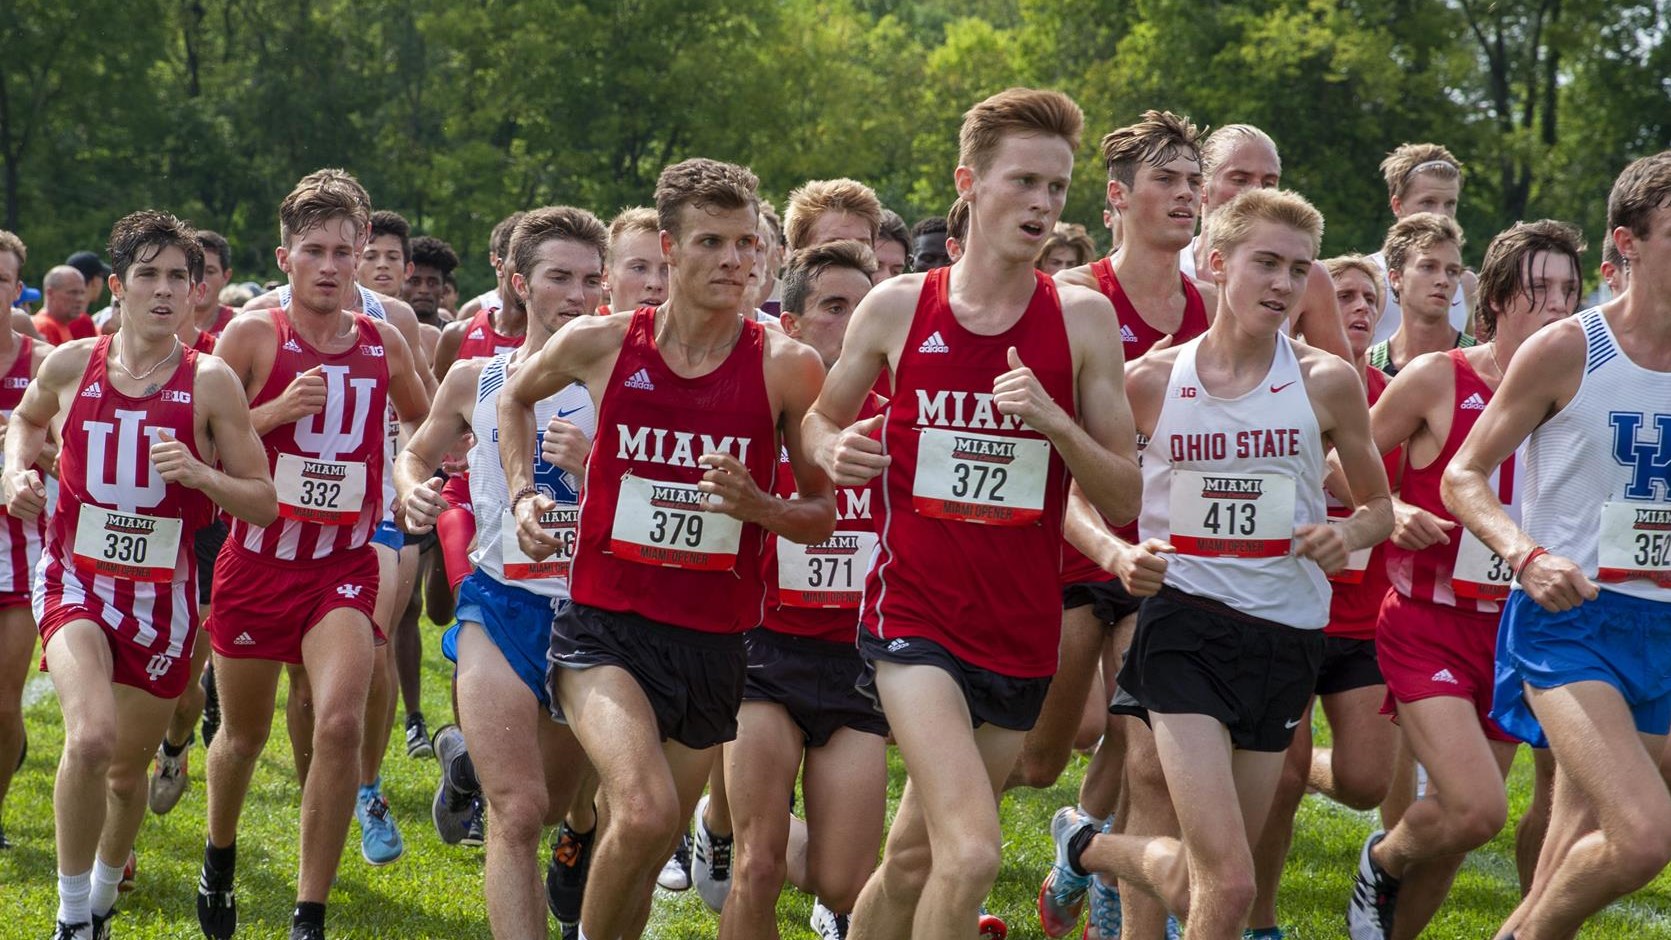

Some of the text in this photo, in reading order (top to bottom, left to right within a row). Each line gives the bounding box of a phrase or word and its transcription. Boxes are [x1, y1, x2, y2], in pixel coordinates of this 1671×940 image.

[918, 345, 949, 353] adidas
[624, 380, 654, 391] adidas
[915, 389, 1034, 431] MIA
[957, 438, 1013, 457] MIAMI
[1170, 429, 1300, 462] OHIO STATE
[305, 463, 346, 476] MIAMI
[952, 463, 1008, 502] 372
[300, 480, 340, 509] 332
[1206, 479, 1260, 493] MIAMI
[108, 514, 154, 530] MIAMI
[649, 510, 704, 548] 379
[1203, 502, 1256, 536] 413
[103, 533, 148, 564] 330
[1634, 533, 1671, 567] 352
[808, 557, 852, 588] 371
